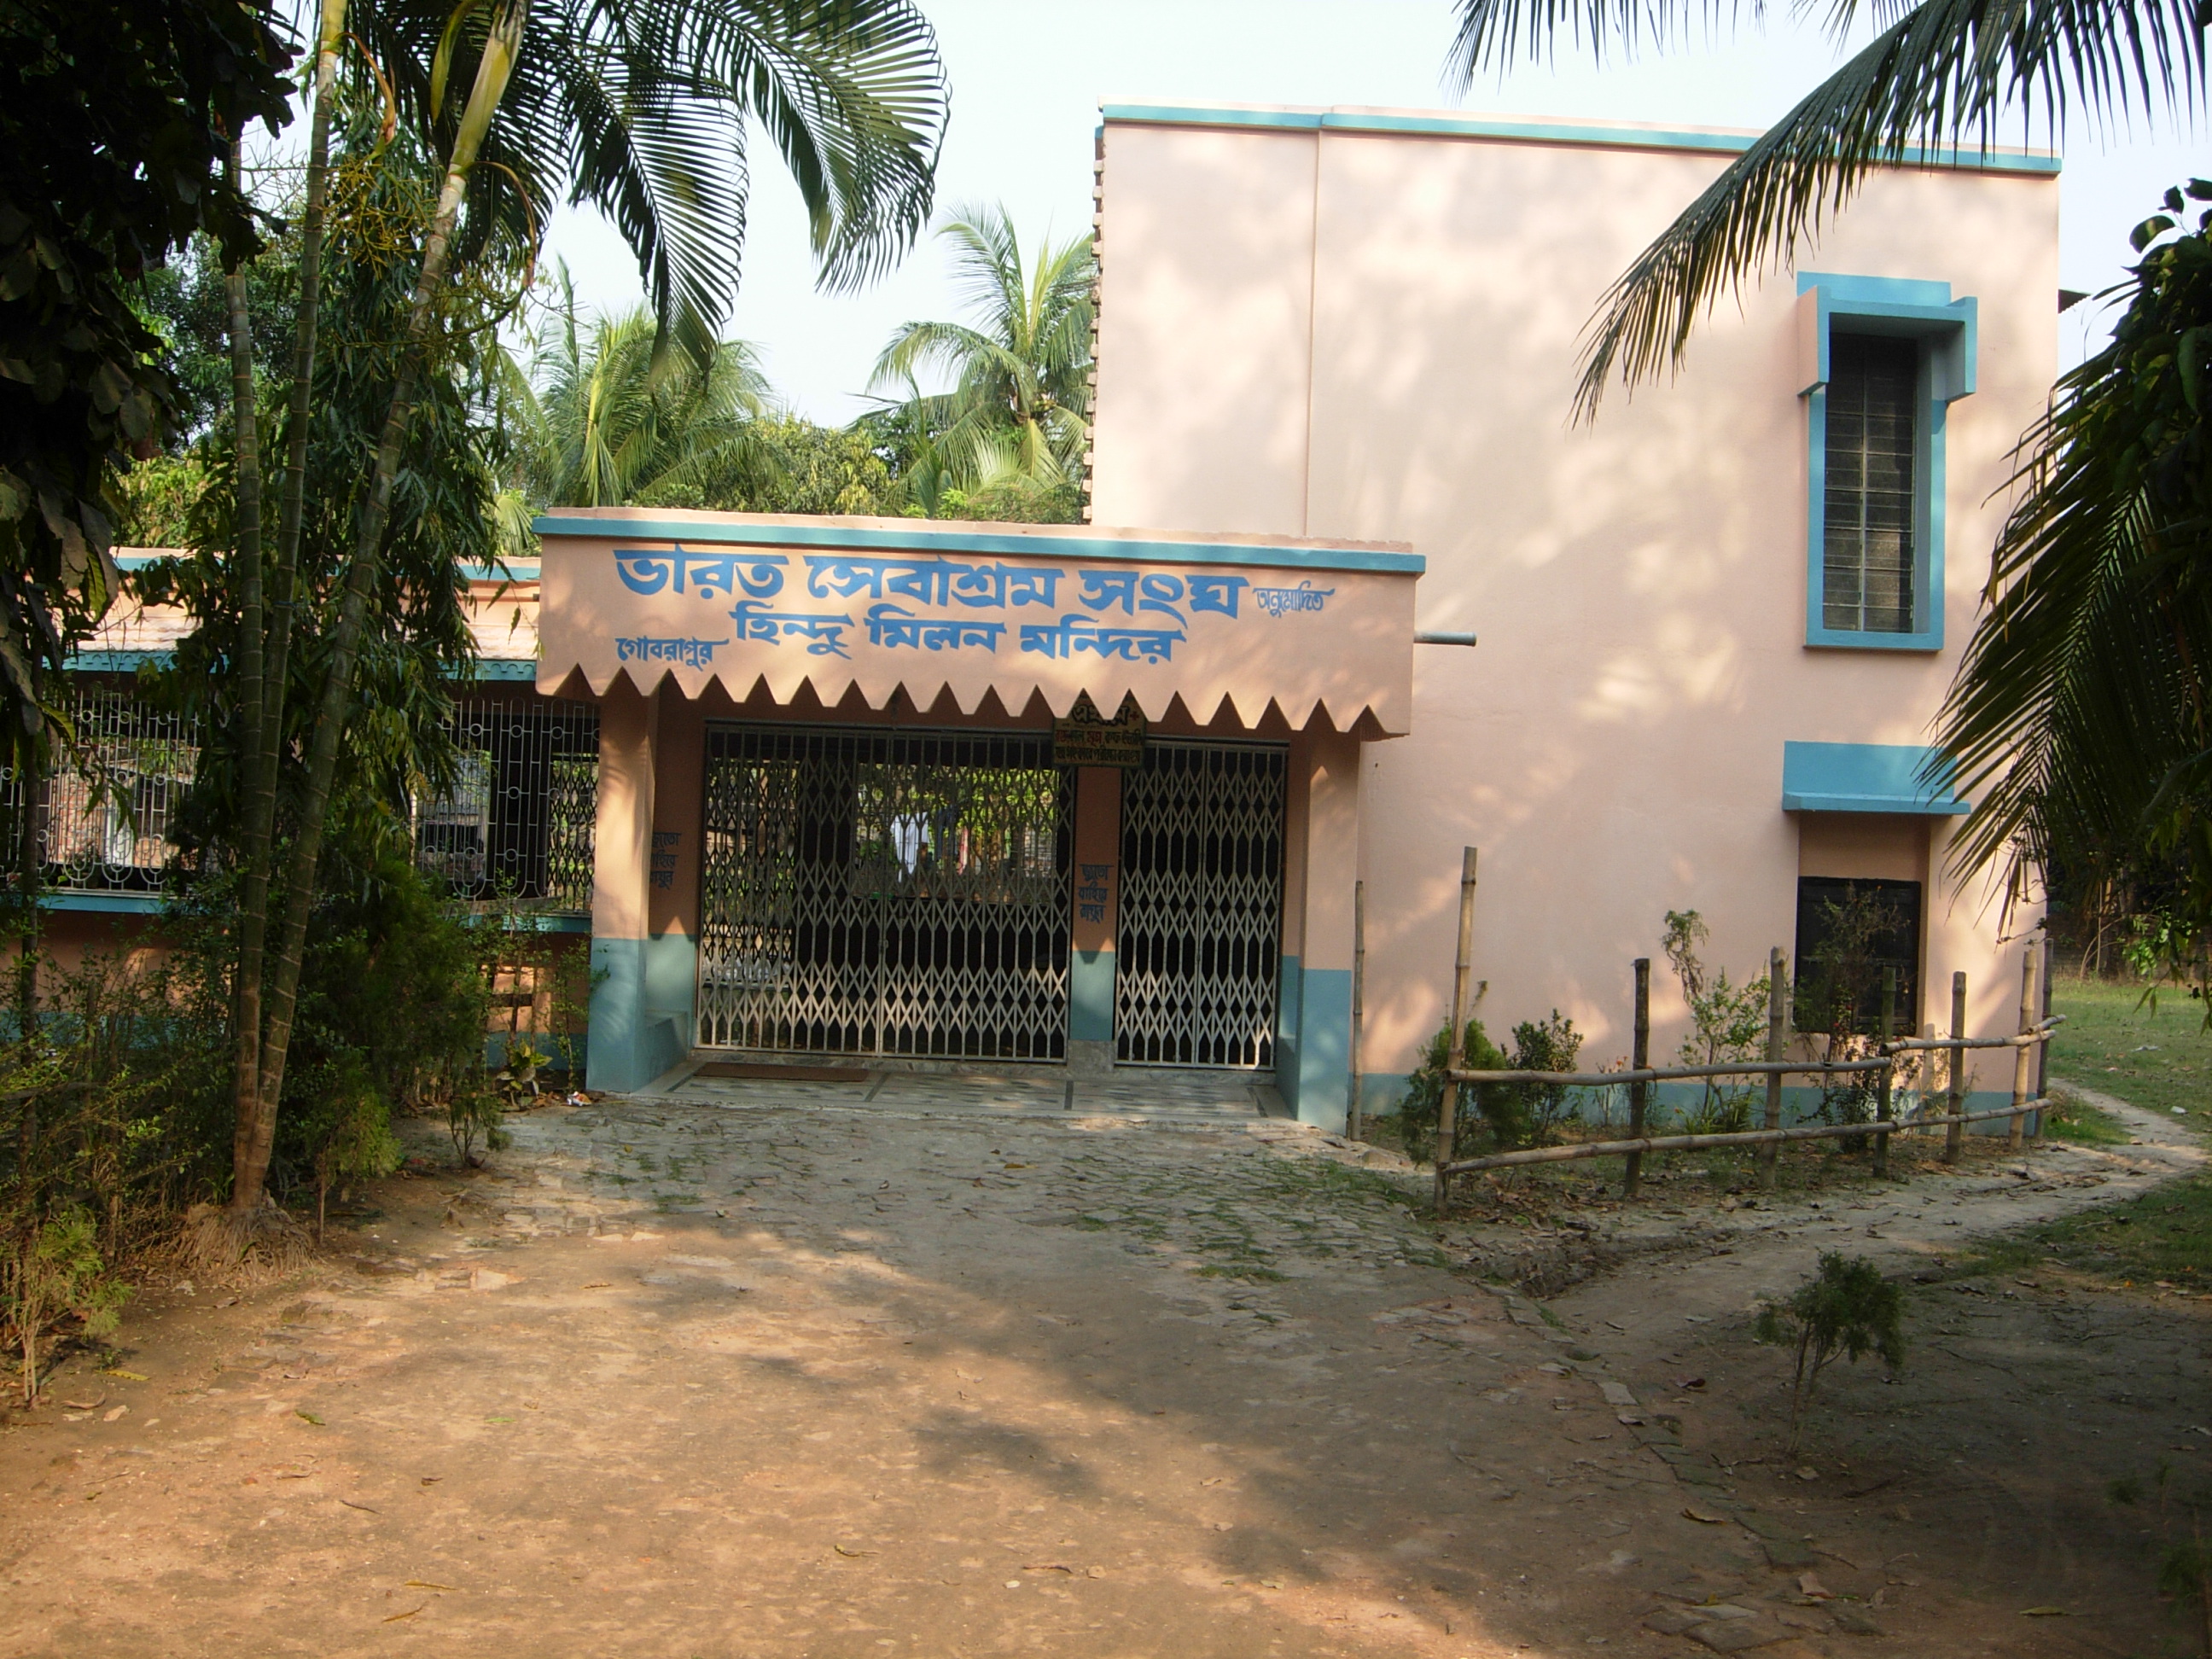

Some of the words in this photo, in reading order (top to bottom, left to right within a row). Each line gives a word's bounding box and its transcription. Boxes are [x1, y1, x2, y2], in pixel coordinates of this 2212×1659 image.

[613, 544, 789, 599] ভারত
[803, 555, 1065, 608] সেবাশ্রম
[1078, 569, 1250, 629] সংঘ
[1252, 579, 1336, 618] অনুমোদিত
[614, 636, 730, 672] গোবরাপুর
[728, 599, 855, 660] হিন্দু
[863, 602, 1007, 652] মিলন
[1018, 613, 1187, 664] মন্দির
[650, 849, 678, 869] াহিরে
